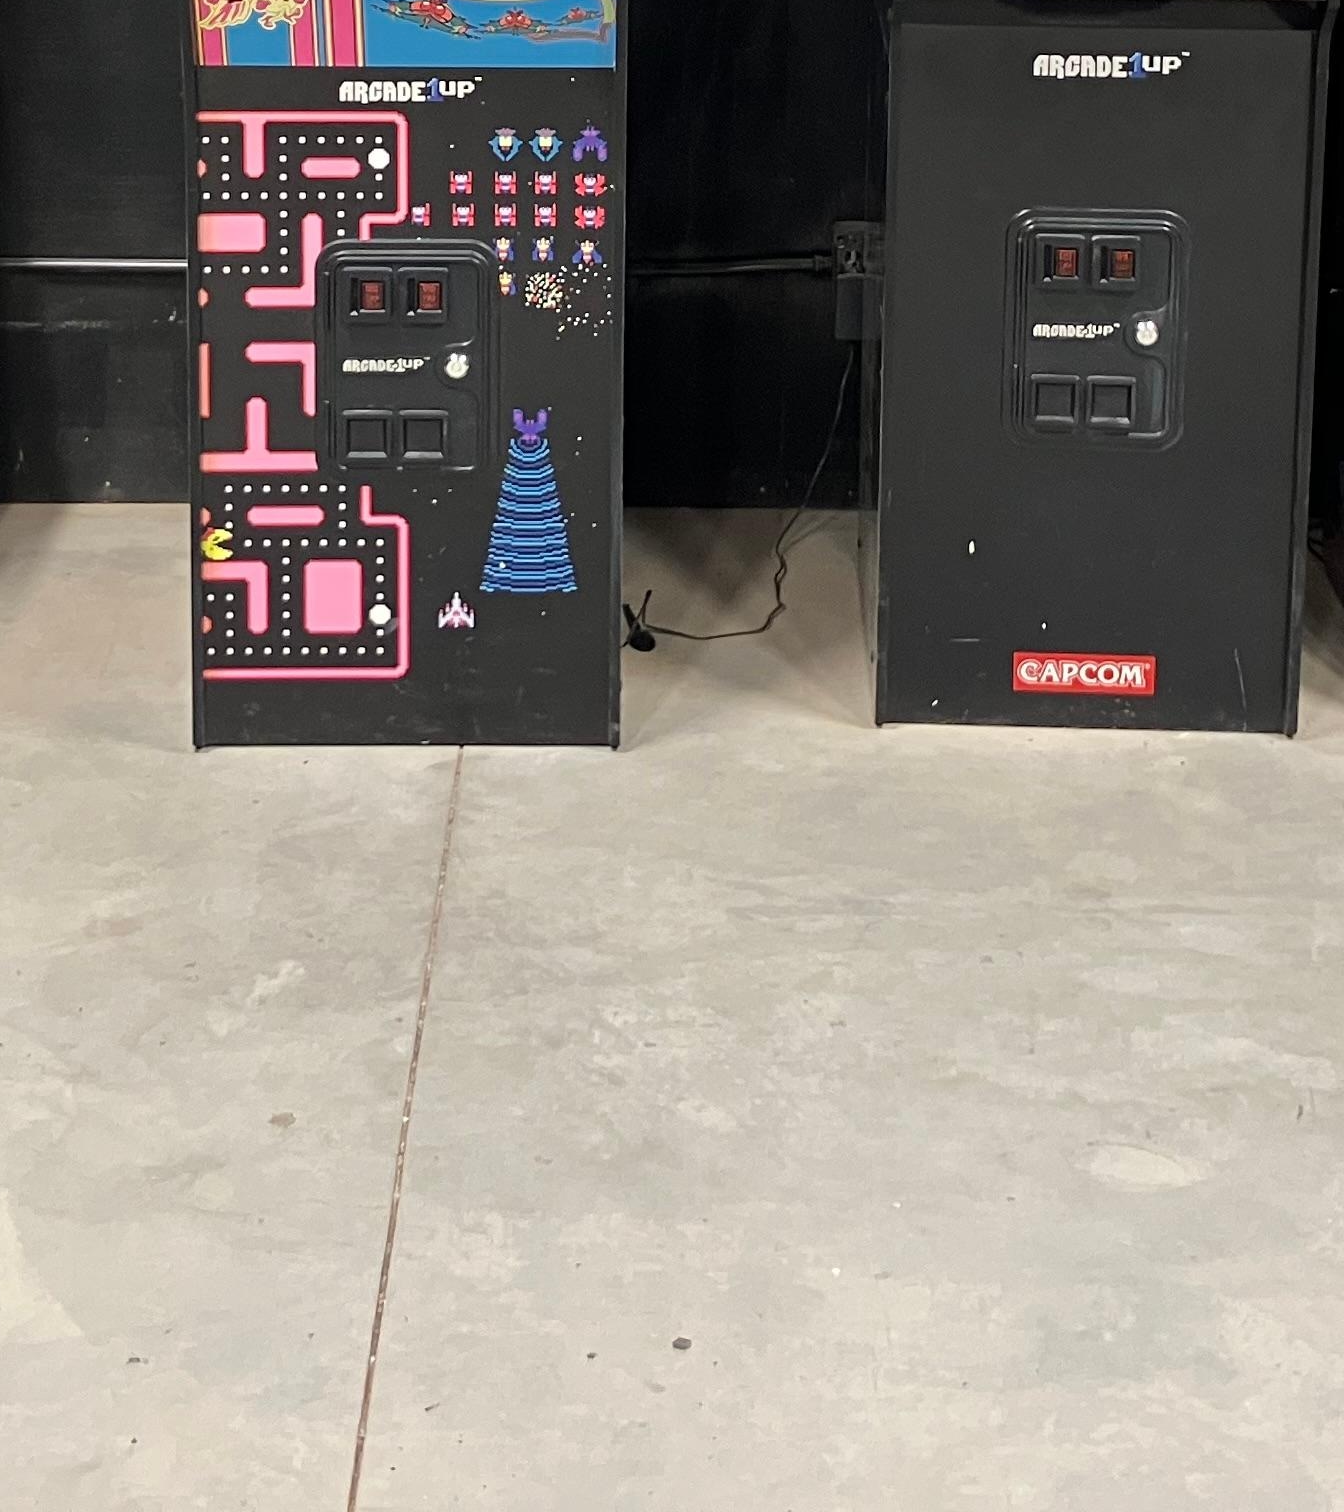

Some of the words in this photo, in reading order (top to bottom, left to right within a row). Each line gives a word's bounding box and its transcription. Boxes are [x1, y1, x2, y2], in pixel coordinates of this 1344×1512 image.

[1032, 51, 1183, 80] ARCADE1UP
[338, 76, 476, 105] ARCADE1UP
[1017, 660, 1146, 688] CAPCOM
